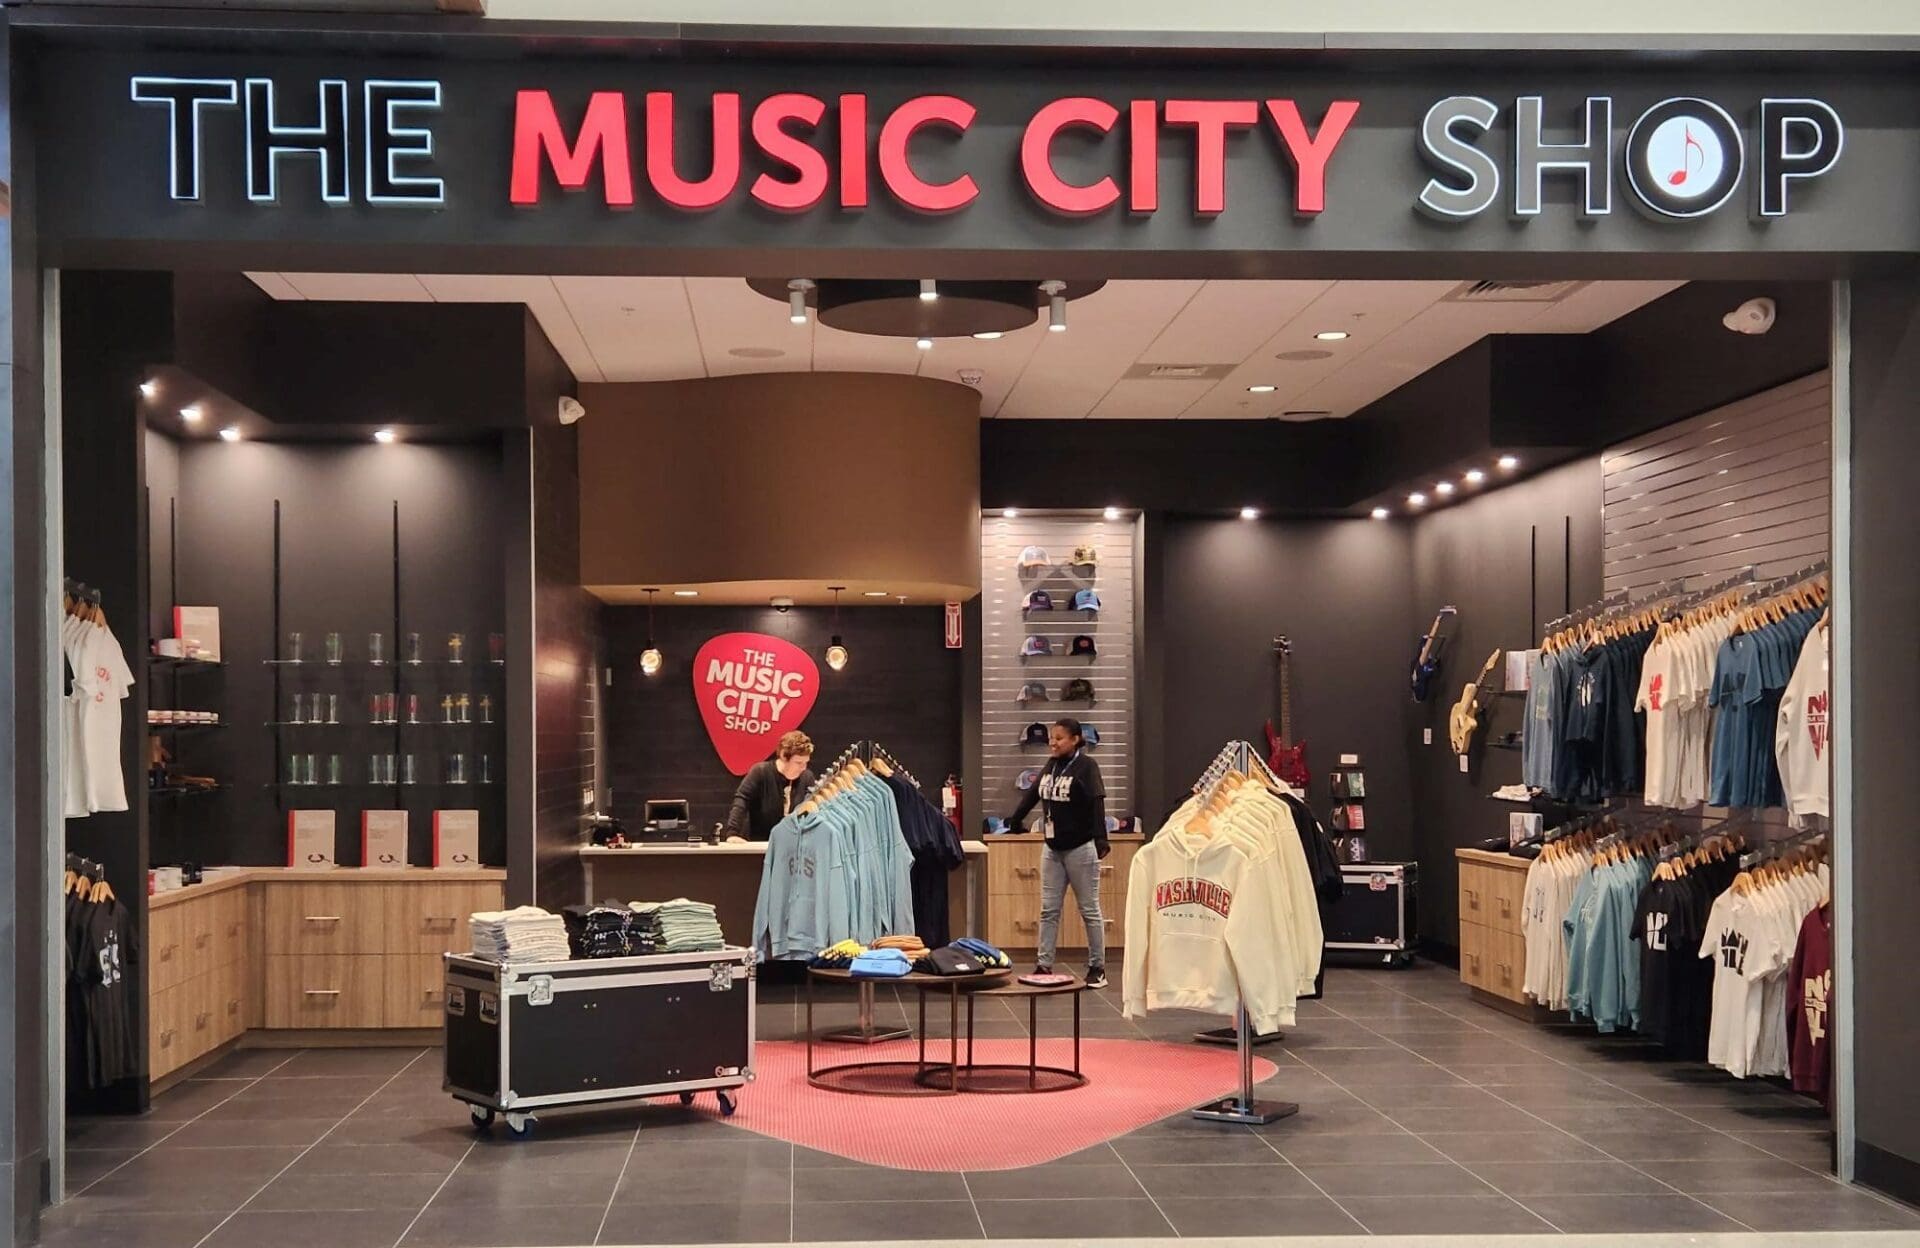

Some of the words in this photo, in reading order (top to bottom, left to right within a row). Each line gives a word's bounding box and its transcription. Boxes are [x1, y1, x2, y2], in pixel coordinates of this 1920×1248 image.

[131, 76, 445, 205] THE
[509, 89, 980, 212] MUSIC
[1019, 97, 1361, 218] CITY
[1416, 95, 1845, 220] SHOP
[743, 648, 776, 667] THE
[706, 658, 804, 698] MUSIC
[717, 688, 790, 722] CITY
[724, 715, 772, 735] SHOP
[1156, 877, 1232, 919] NASHVILLE
